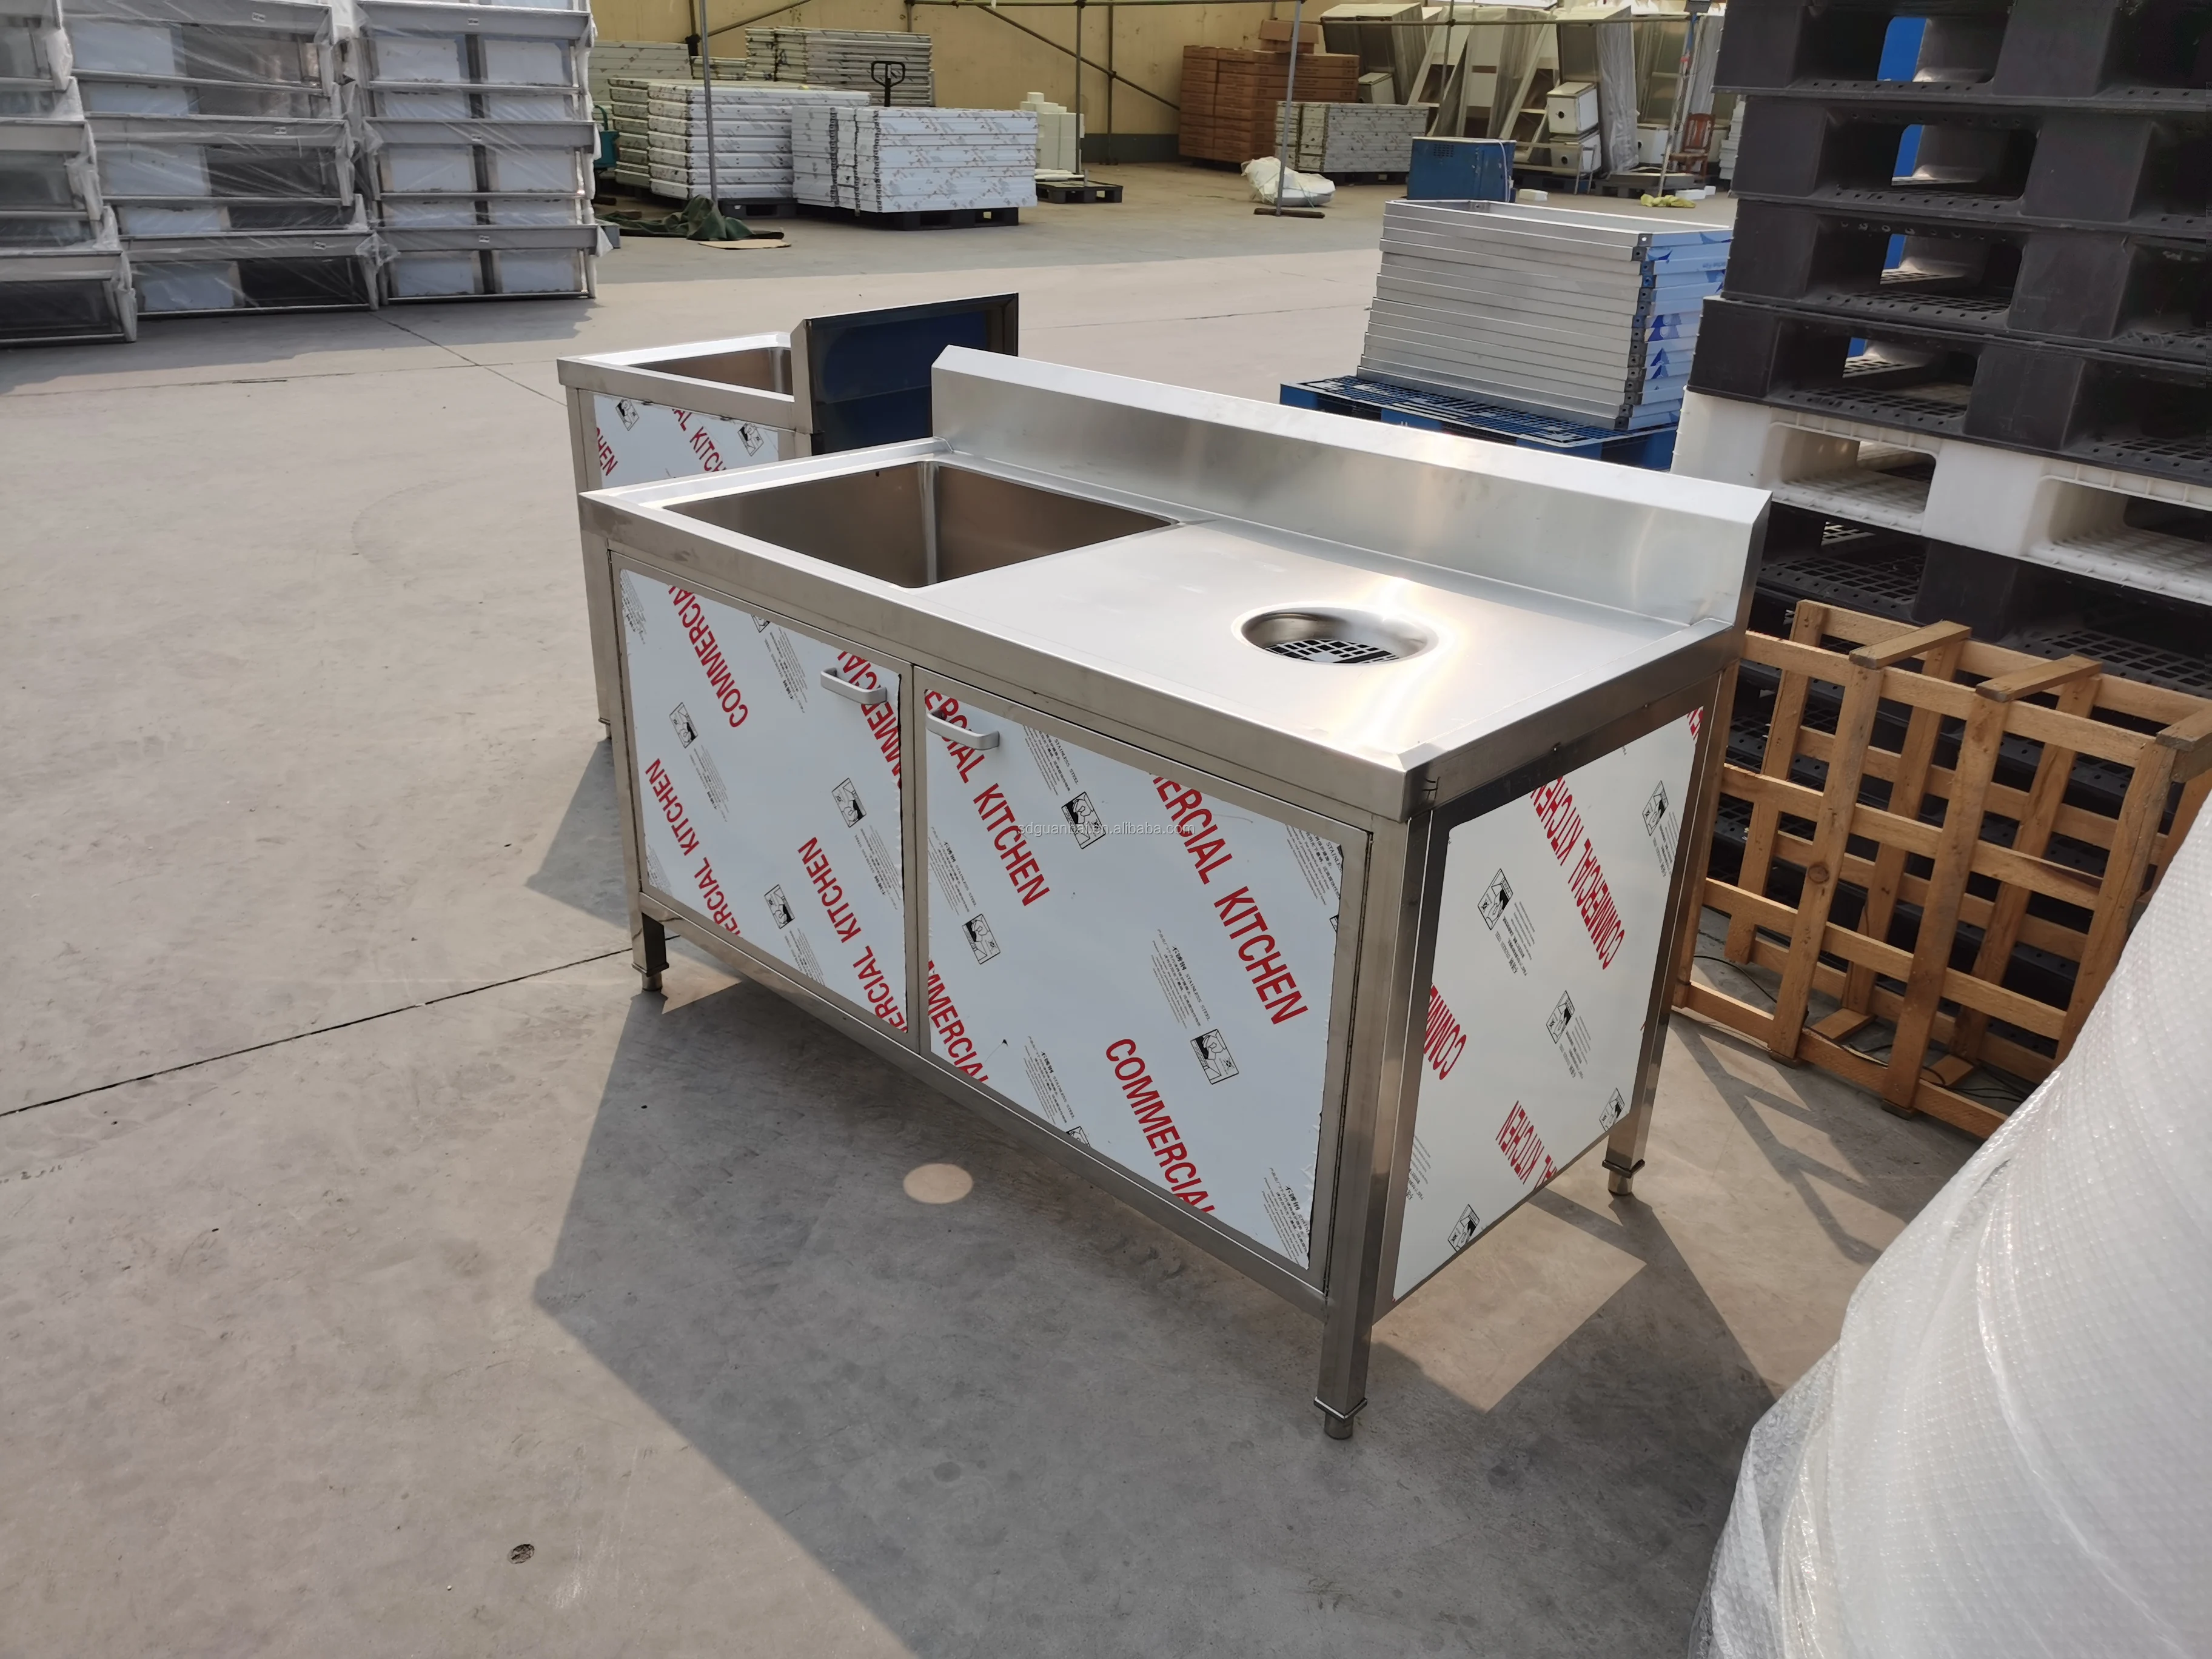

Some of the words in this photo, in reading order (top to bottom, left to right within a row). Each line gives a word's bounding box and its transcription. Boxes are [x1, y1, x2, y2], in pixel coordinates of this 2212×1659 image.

[645, 759, 700, 856] KITCHEN
[973, 783, 1050, 906] KITCHEN
[694, 857, 741, 936] ERCIAL
[798, 836, 861, 943] KITCHEN
[1569, 838, 1625, 970] COMMERCIAL
[853, 945, 908, 1032] ERCIAL
[1214, 886, 1308, 1025] KITCHEN
[1496, 1101, 1544, 1185] KITCHEN
